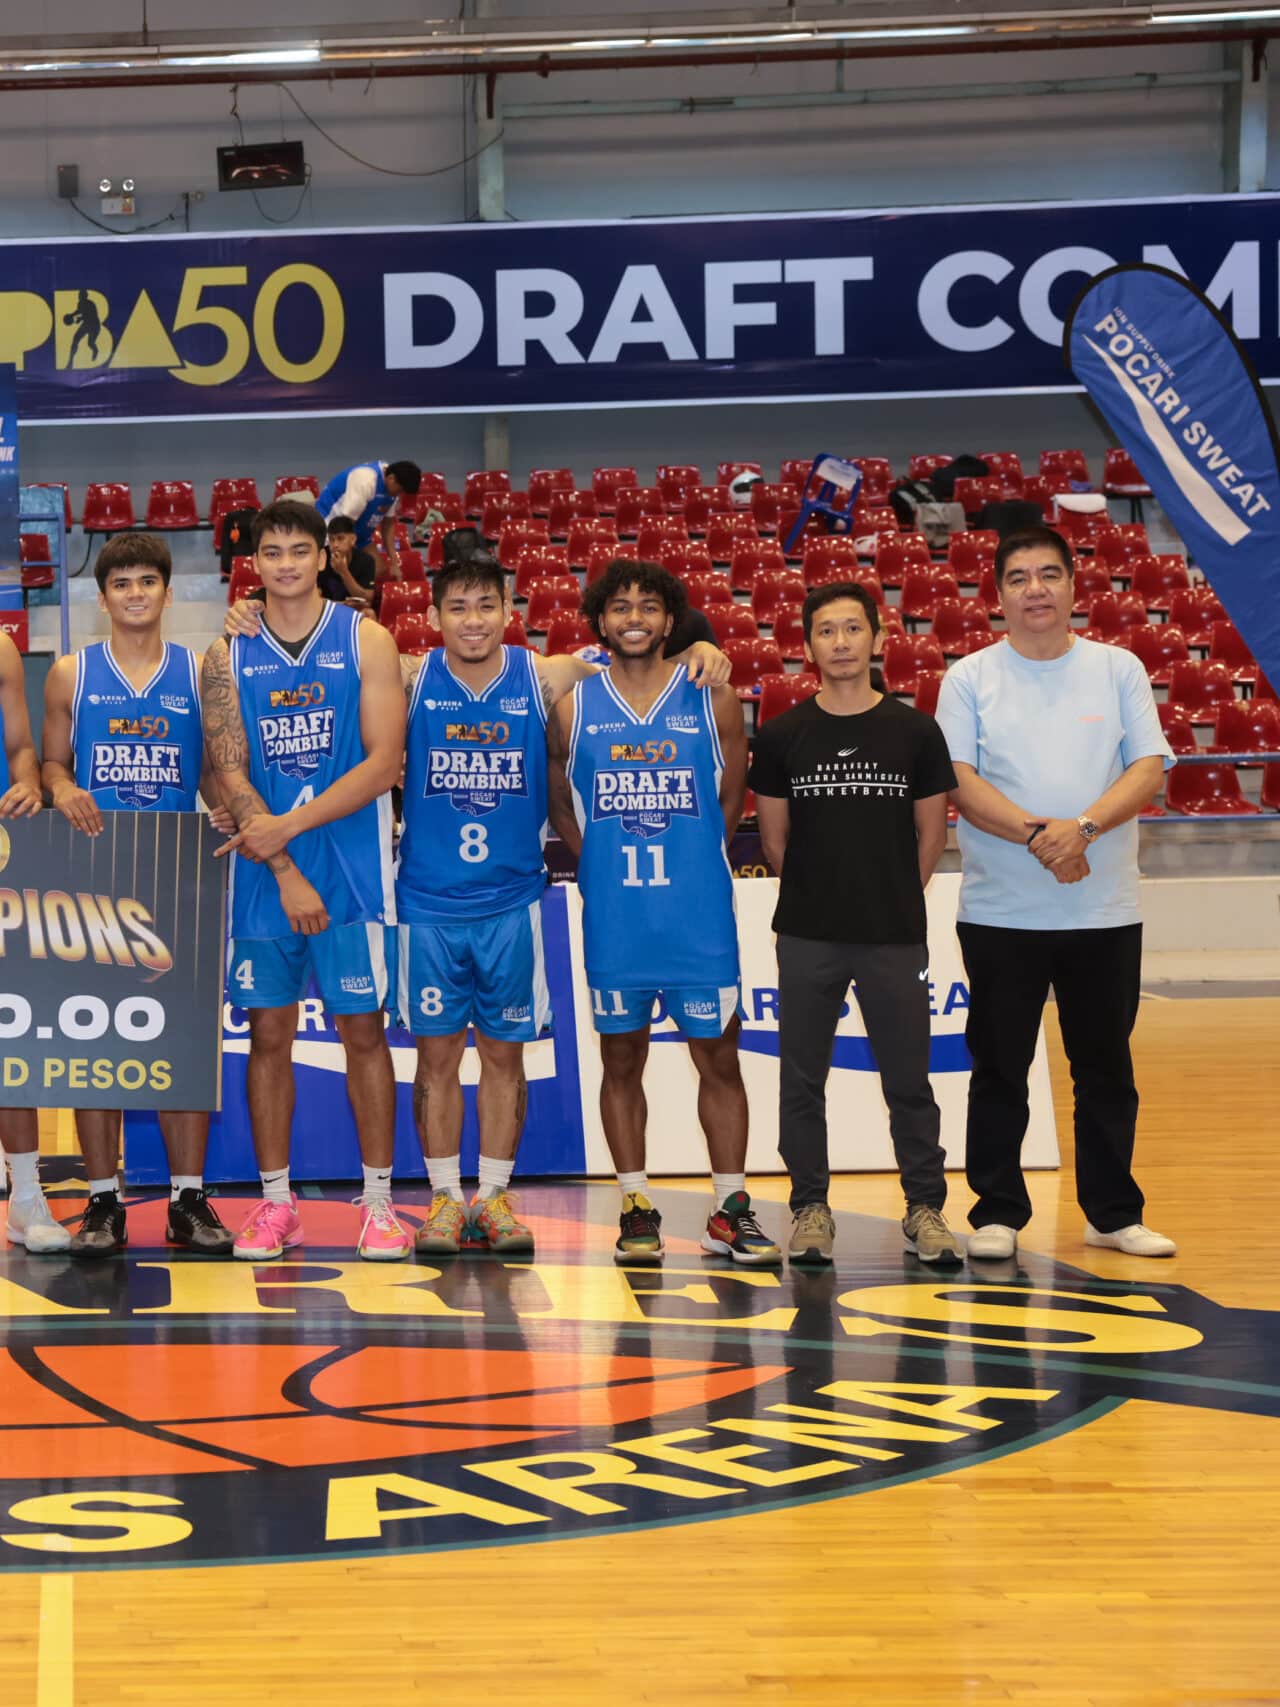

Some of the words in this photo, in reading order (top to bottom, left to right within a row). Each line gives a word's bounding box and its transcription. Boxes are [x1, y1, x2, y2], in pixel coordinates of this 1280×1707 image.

[384, 256, 874, 369] DRAFT
[918, 241, 1280, 353] COM
[1094, 313, 1191, 424] POCARI
[1183, 421, 1270, 518] SWEAT
[260, 709, 333, 741] DRAFT
[95, 745, 179, 767] DRAFT
[431, 750, 523, 773] DRAFT
[96, 766, 180, 783] COMBINE
[431, 773, 523, 790] COMBINE
[597, 770, 692, 795] DRAFT
[599, 792, 693, 811] COMBINE
[459, 822, 489, 863] 8
[621, 845, 670, 887] 11
[235, 960, 255, 990] 4
[420, 986, 444, 1017] 8
[591, 988, 629, 1017] 11
[44, 1058, 173, 1091] PESOS
[323, 1379, 1061, 1541] ARENA
